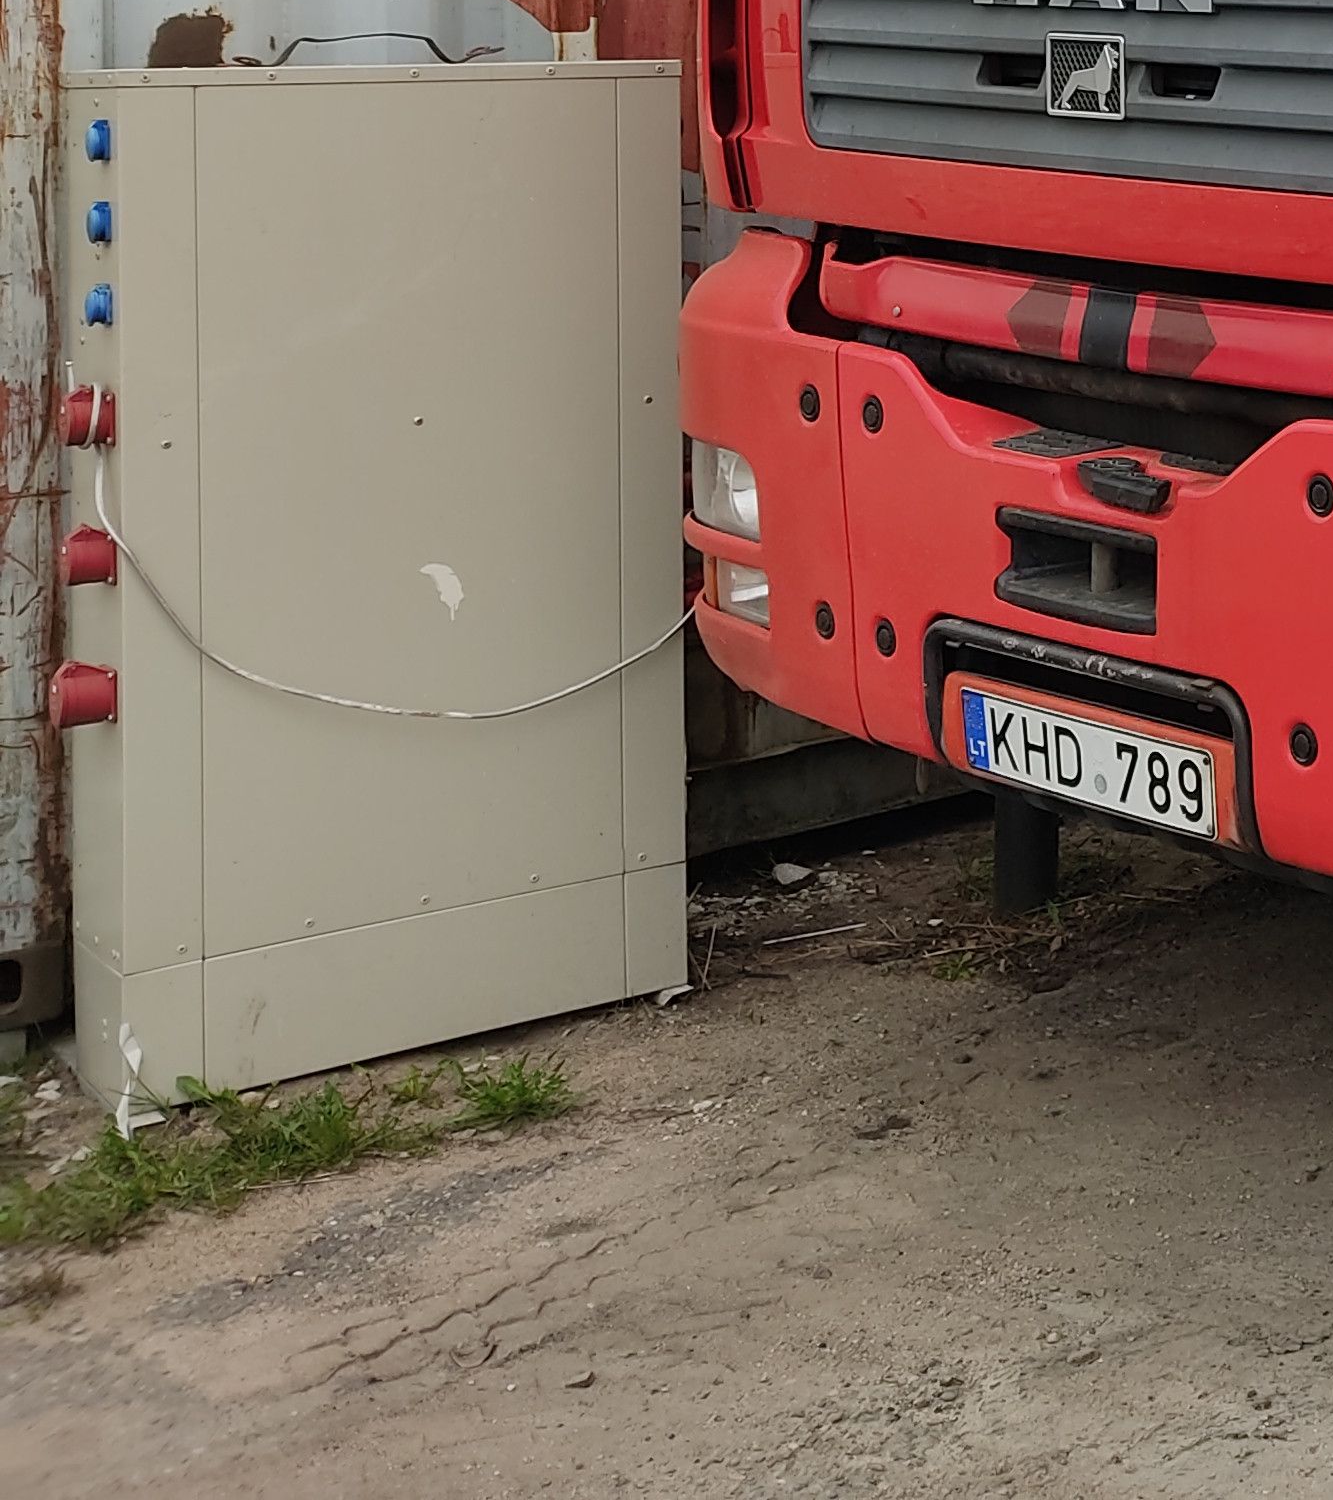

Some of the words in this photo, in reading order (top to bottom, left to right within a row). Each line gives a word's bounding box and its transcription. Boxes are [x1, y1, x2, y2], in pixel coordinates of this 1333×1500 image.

[969, 738, 987, 758] LT
[989, 707, 1083, 788] KHD
[1115, 741, 1203, 823] 789
